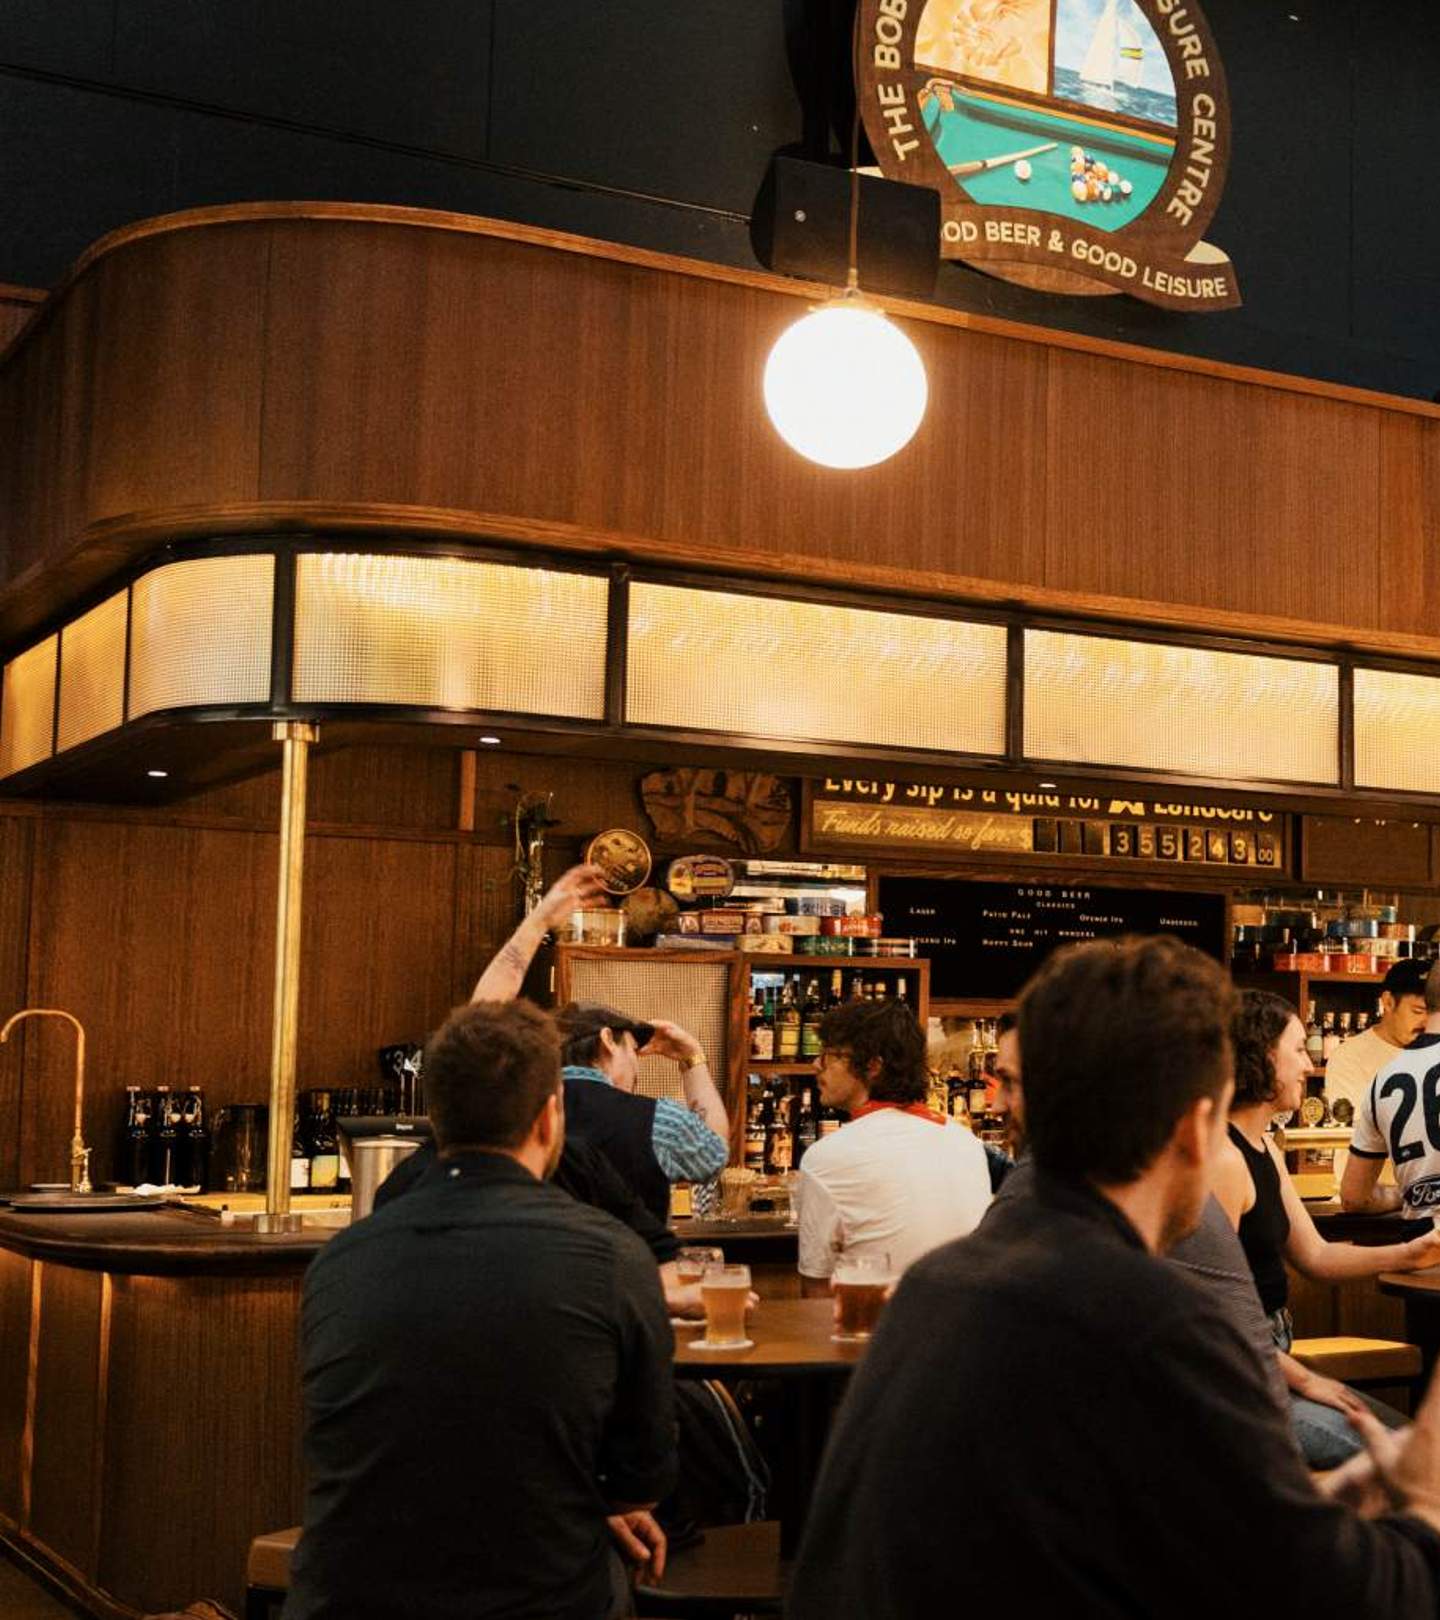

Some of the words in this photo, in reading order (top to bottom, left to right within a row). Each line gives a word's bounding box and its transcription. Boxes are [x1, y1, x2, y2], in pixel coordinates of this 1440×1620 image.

[877, 84, 920, 161] THE
[1166, 93, 1216, 226] CENTRE
[941, 220, 978, 242] OD
[985, 220, 1041, 247] BEER
[1048, 229, 1064, 252] &
[1071, 239, 1137, 278] GOOD
[1142, 266, 1228, 298] LEISURE
[822, 809, 883, 836] Funds
[884, 816, 957, 840] raised
